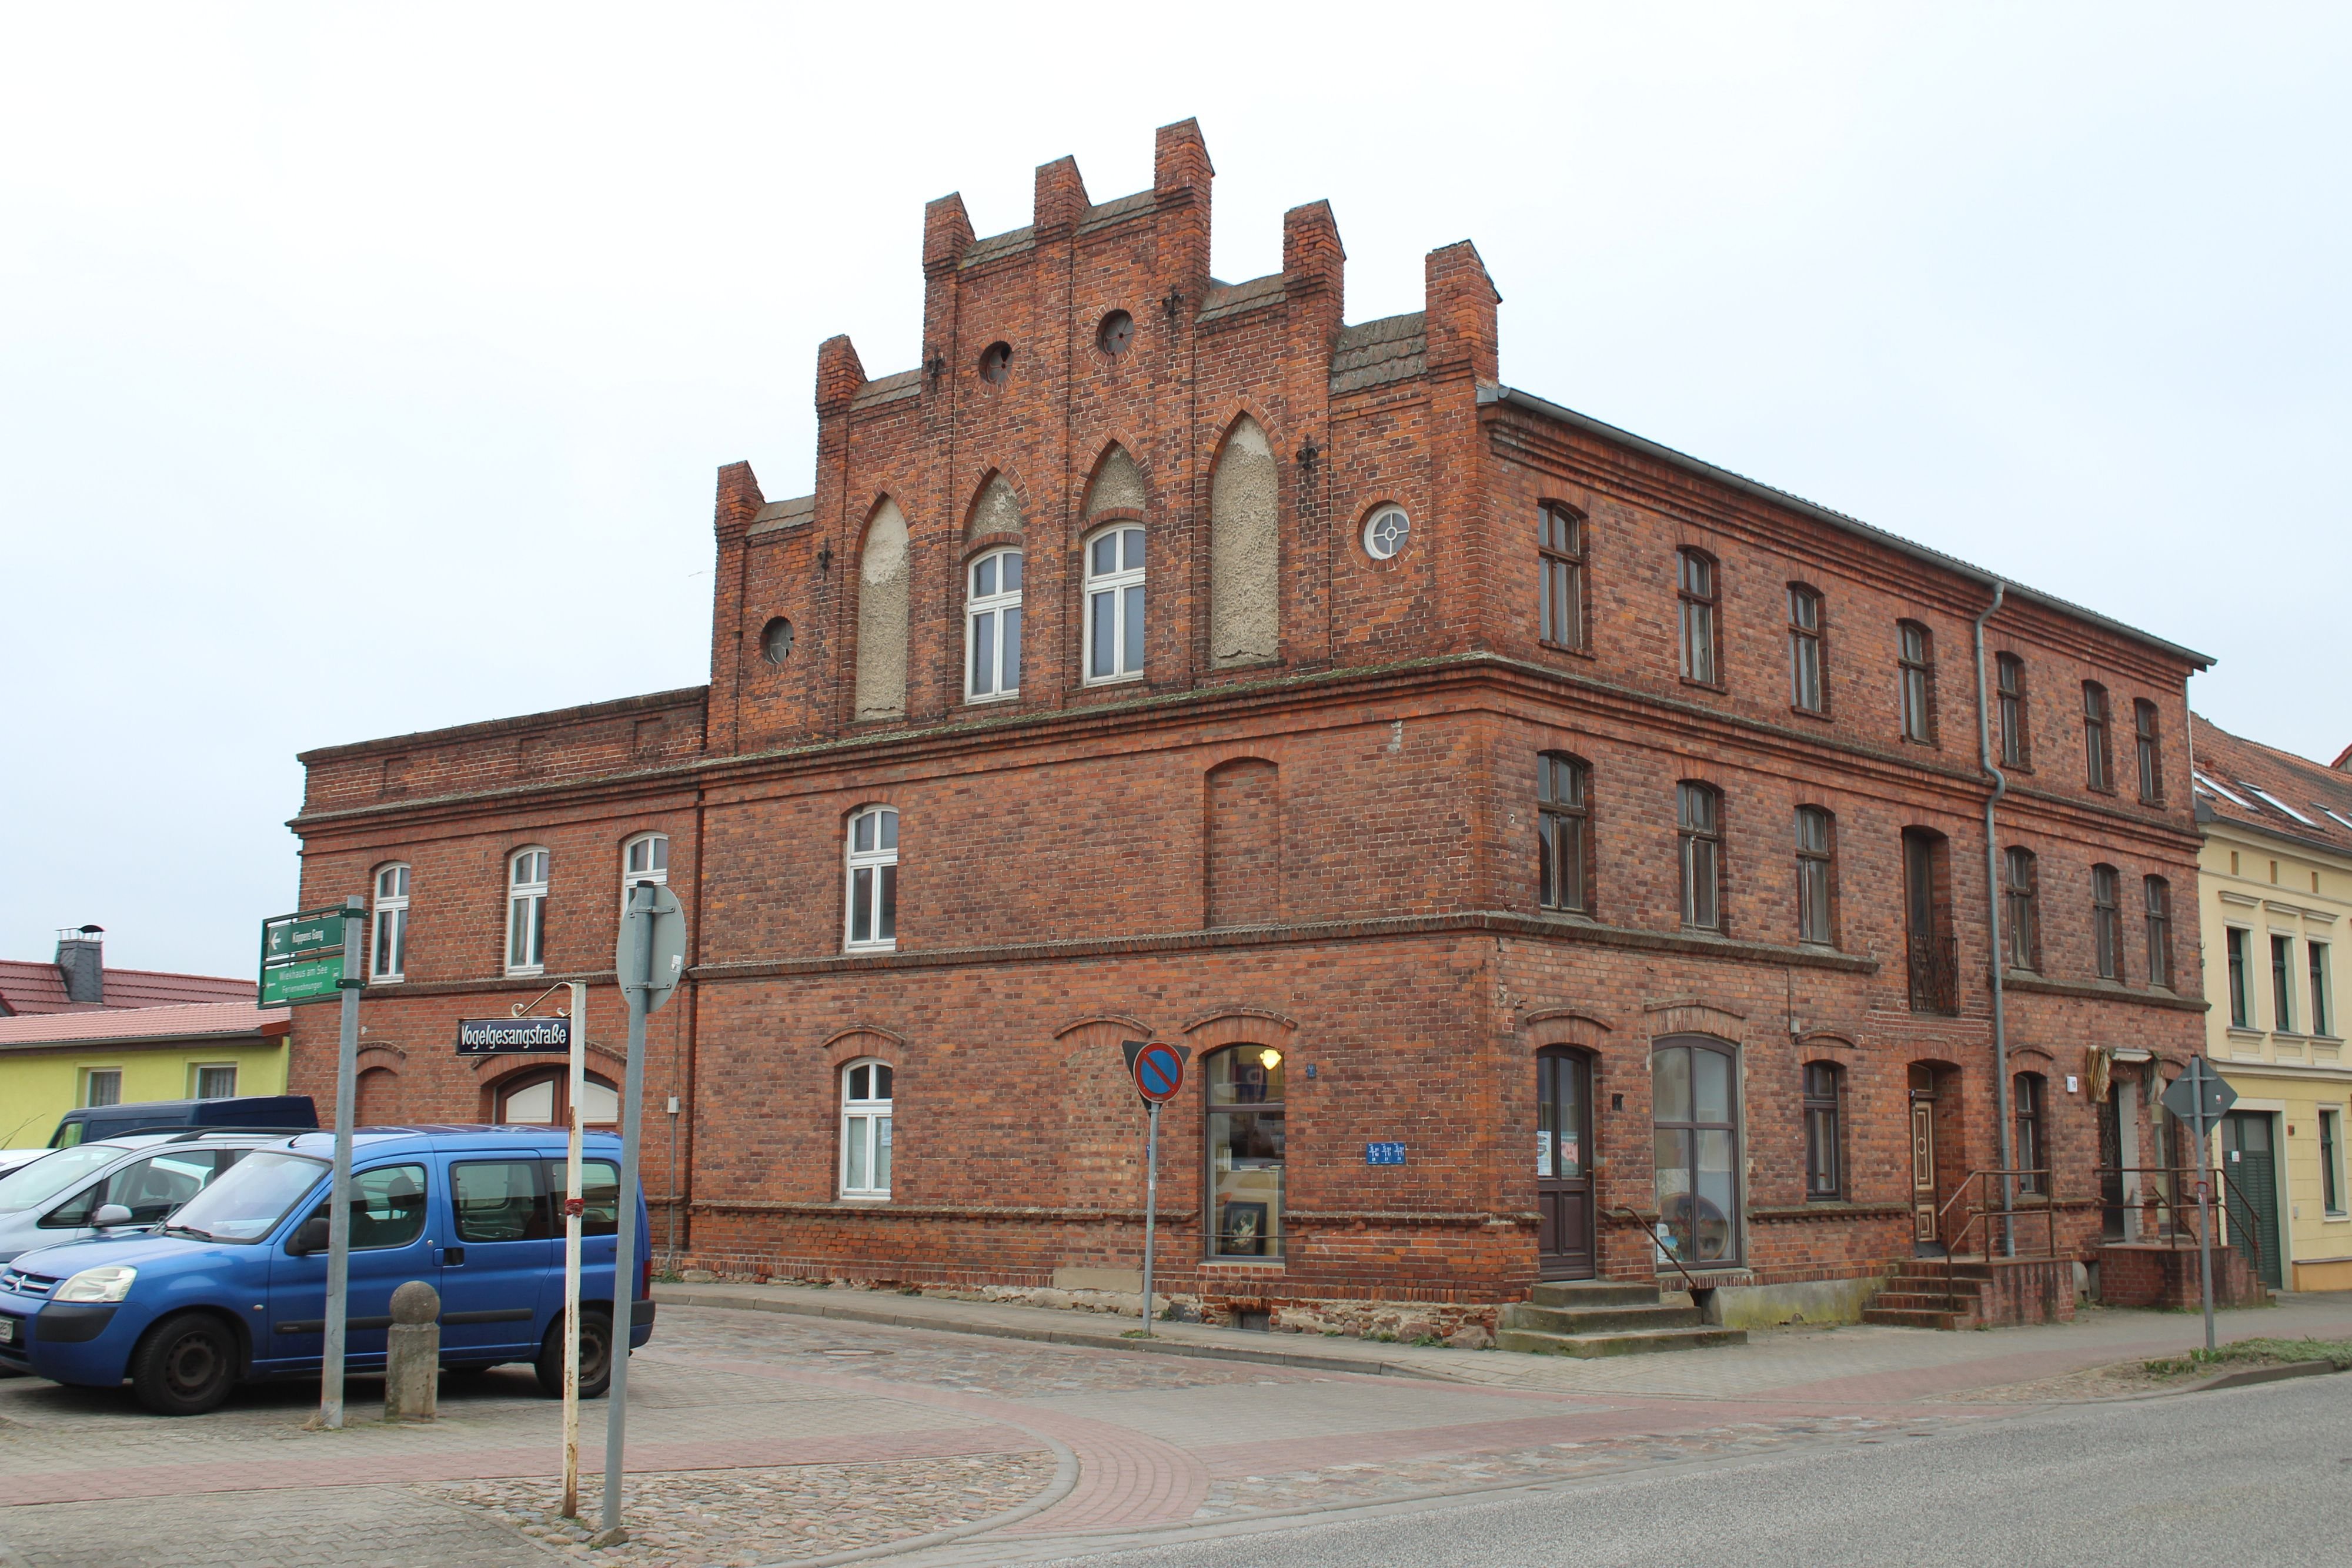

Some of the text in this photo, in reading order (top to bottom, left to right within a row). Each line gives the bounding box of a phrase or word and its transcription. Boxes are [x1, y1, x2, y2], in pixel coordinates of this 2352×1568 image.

[312, 929, 323, 941] Gang
[280, 970, 305, 981] Wiekhaus
[317, 965, 328, 975] See
[283, 982, 322, 993] Ferienwohnungen
[462, 1024, 566, 1049] Vogelgesangstraße
